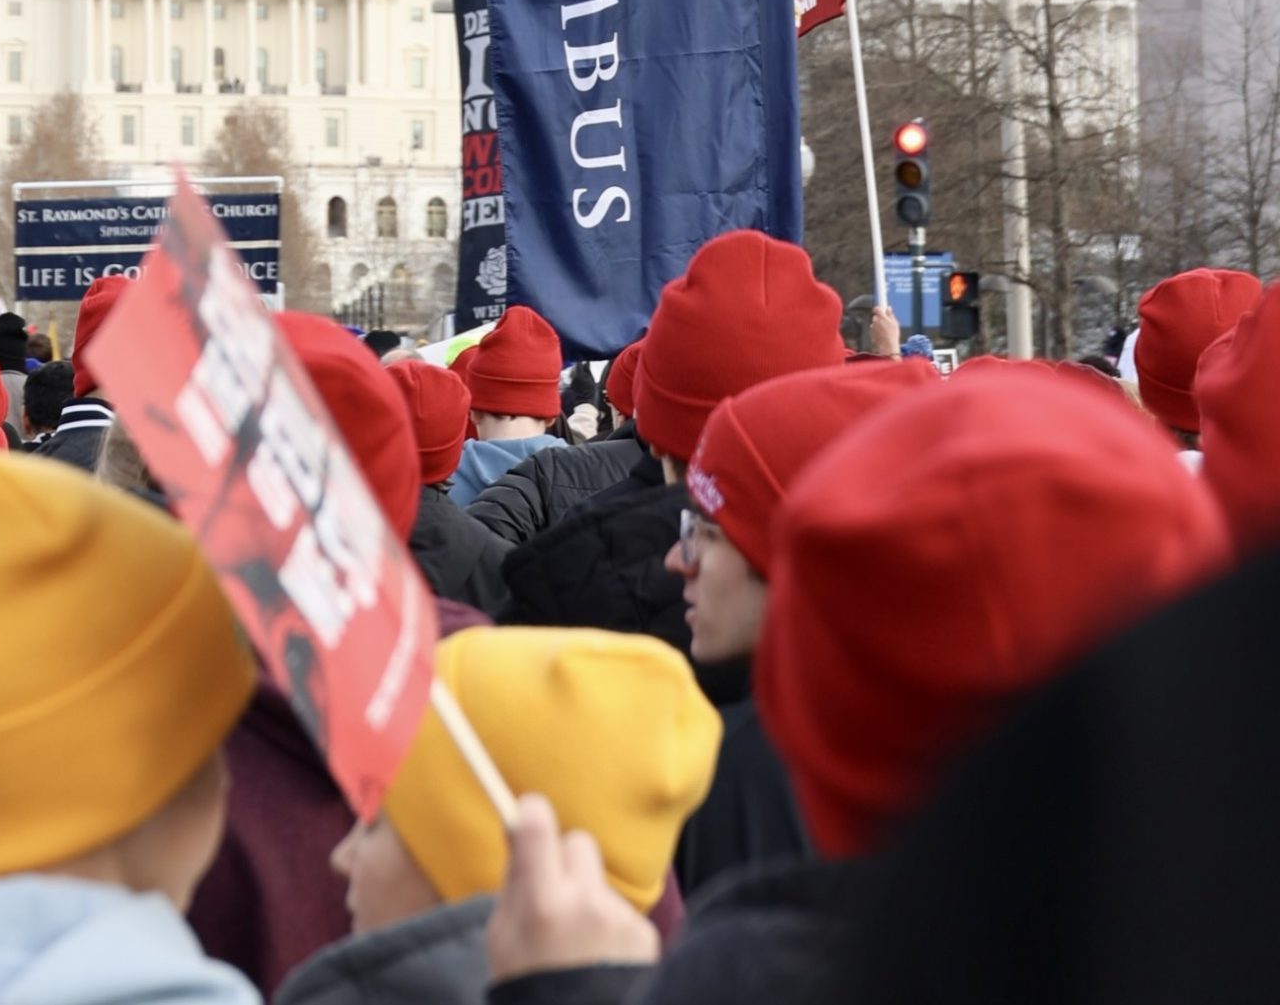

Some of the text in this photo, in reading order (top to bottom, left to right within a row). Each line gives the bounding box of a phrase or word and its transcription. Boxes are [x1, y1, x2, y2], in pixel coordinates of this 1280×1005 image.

[212, 203, 277, 218] CHURCH
[18, 266, 66, 287] LIFE
[75, 267, 96, 286] IS
